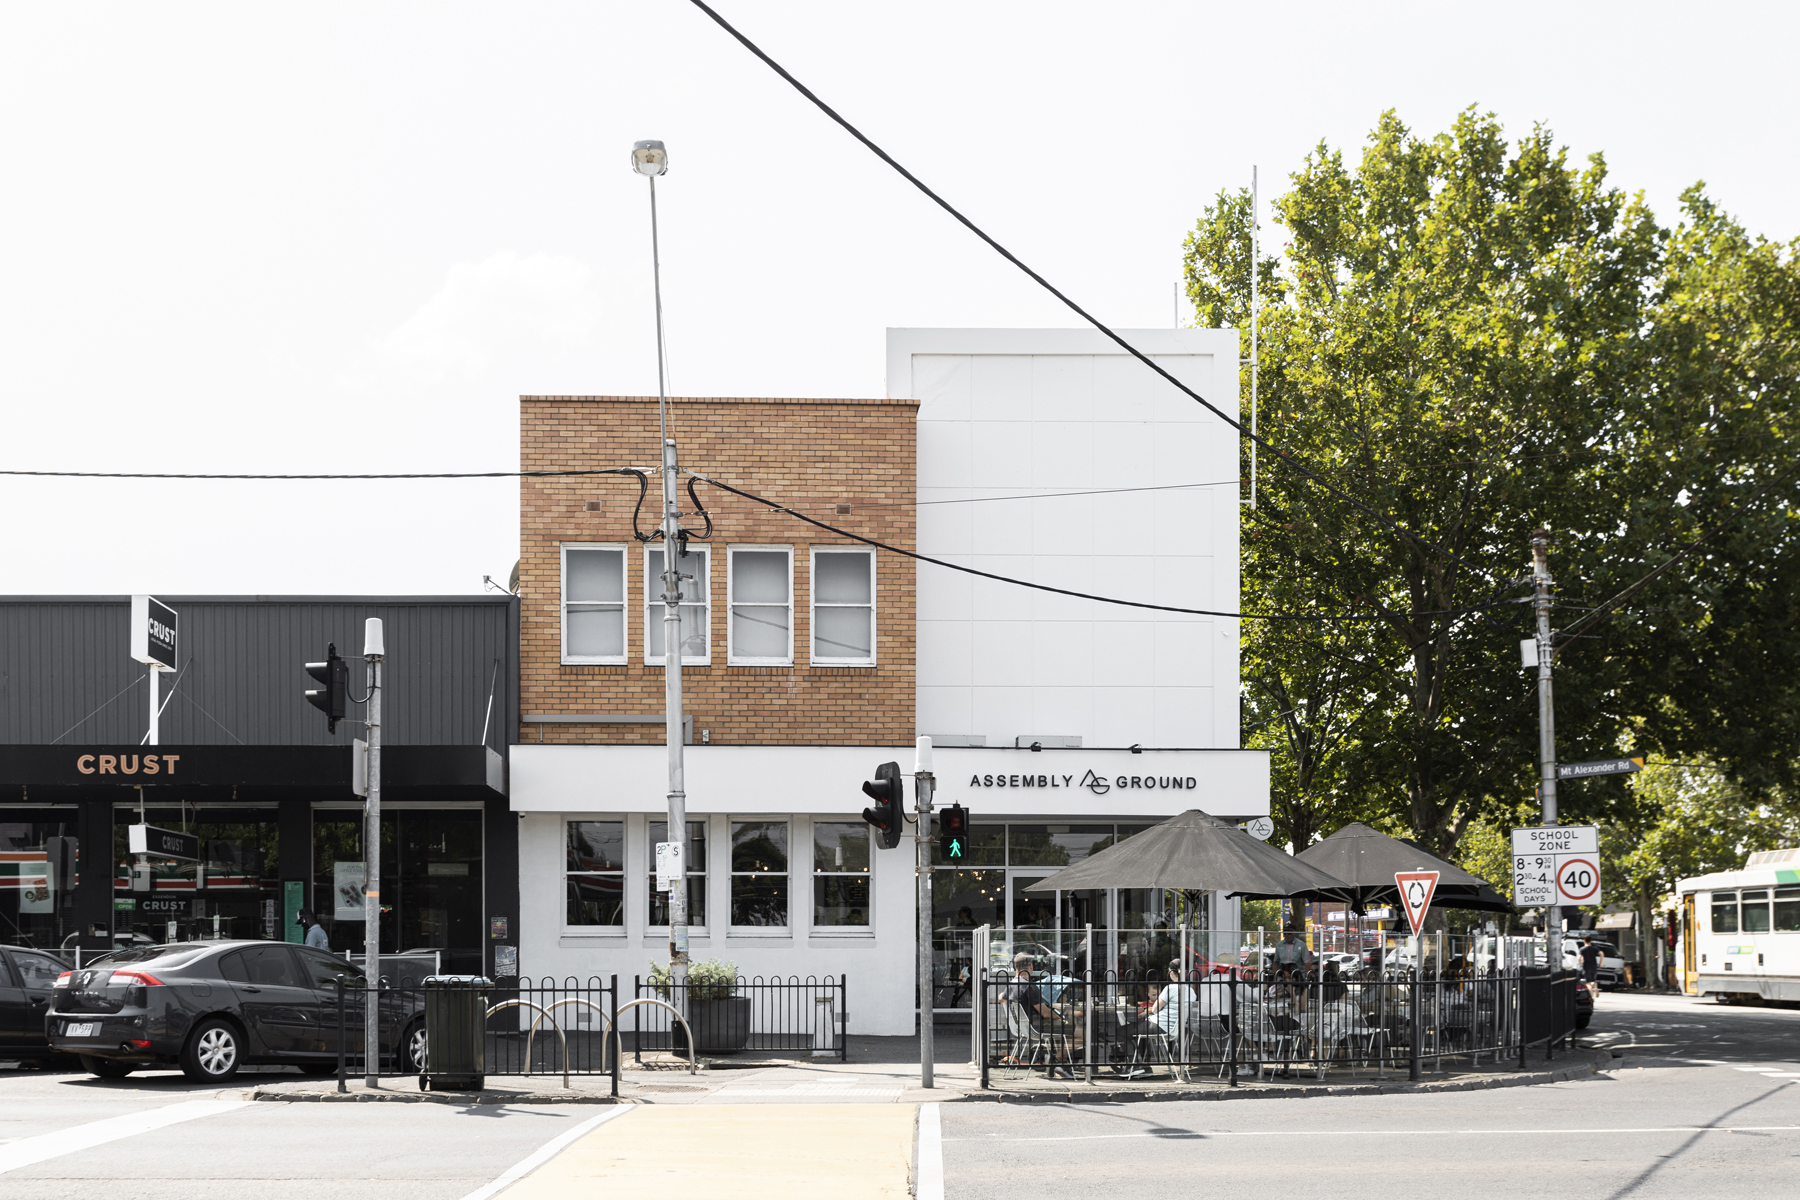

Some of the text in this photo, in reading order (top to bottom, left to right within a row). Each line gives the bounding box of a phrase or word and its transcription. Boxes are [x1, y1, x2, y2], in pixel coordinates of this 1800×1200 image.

[148, 617, 175, 645] CRUST
[77, 754, 180, 775] CRUST
[1560, 761, 1630, 776] Mt Alexander Rd
[970, 774, 1073, 788] ASSEMBLY
[1116, 775, 1197, 790] GROUND
[1530, 830, 1579, 841] SCHOOL
[162, 835, 184, 852] CRUST
[657, 845, 667, 855] 2P
[1539, 841, 1571, 851] ZONE
[1516, 858, 1525, 870] 8
[1538, 872, 1547, 885] 4
[1564, 870, 1591, 888] 40
[1519, 887, 1552, 895] SCHOOL
[142, 901, 186, 910] CRUST
